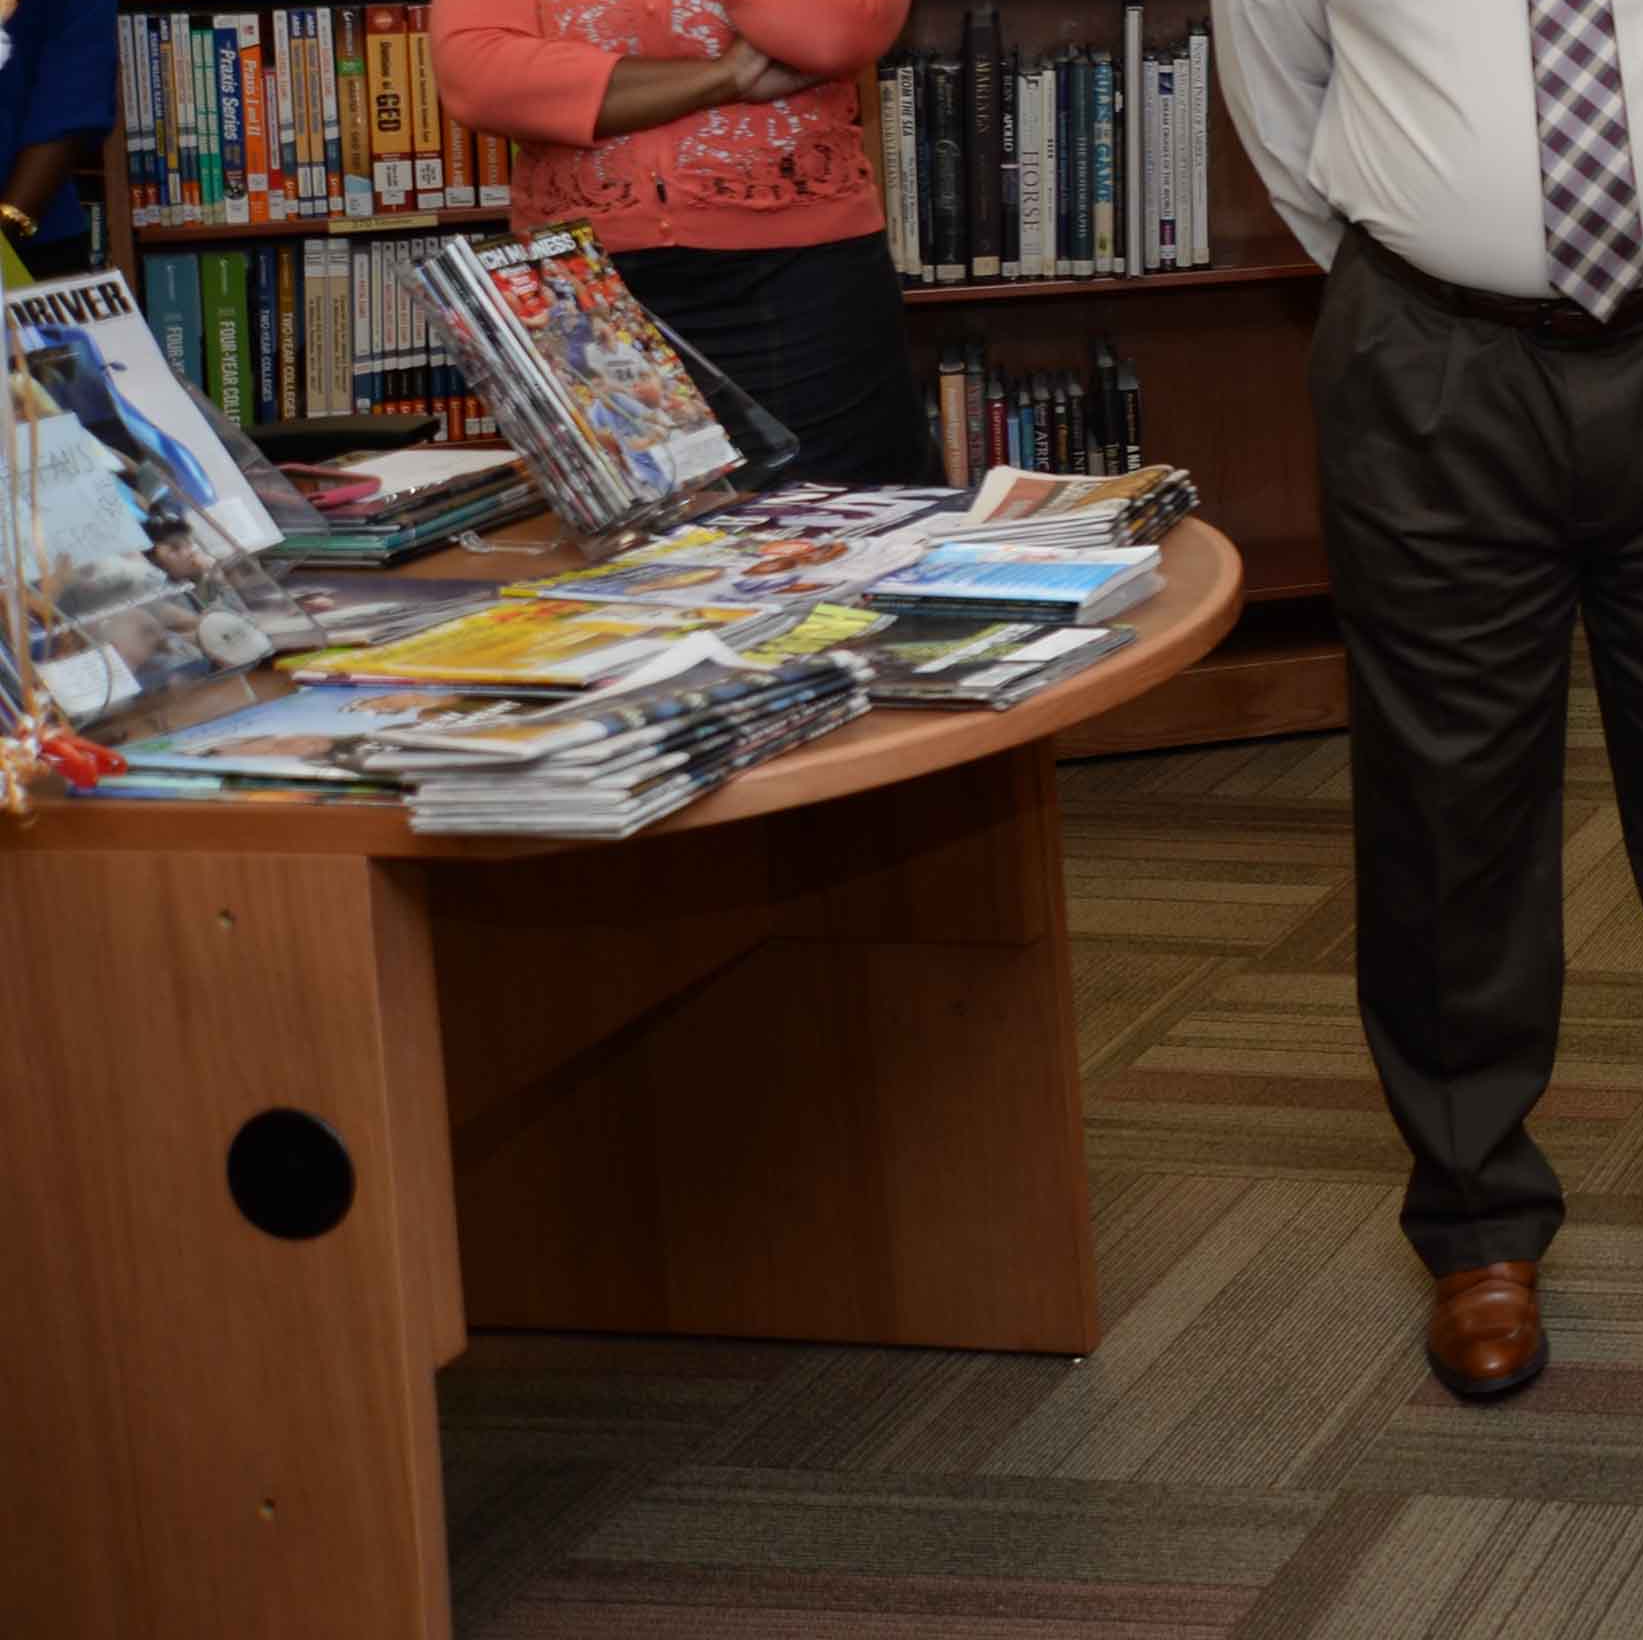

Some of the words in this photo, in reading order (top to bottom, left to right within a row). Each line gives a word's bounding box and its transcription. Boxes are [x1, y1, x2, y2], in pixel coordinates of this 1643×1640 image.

[221, 49, 237, 93] Praxis
[246, 60, 259, 95] Praxis
[901, 69, 912, 99] FROM
[224, 97, 238, 140] Series
[376, 94, 401, 133] GED
[901, 101, 912, 116] THE
[902, 119, 914, 137] SEA
[1021, 151, 1040, 233] HORSE
[218, 320, 239, 385] FOUR-YEAR
[260, 309, 271, 355] TWO-YEAR
[281, 312, 295, 363] TWO-YEAR
[262, 356, 272, 402] COLLEGES
[281, 366, 296, 417] COLLEGES
